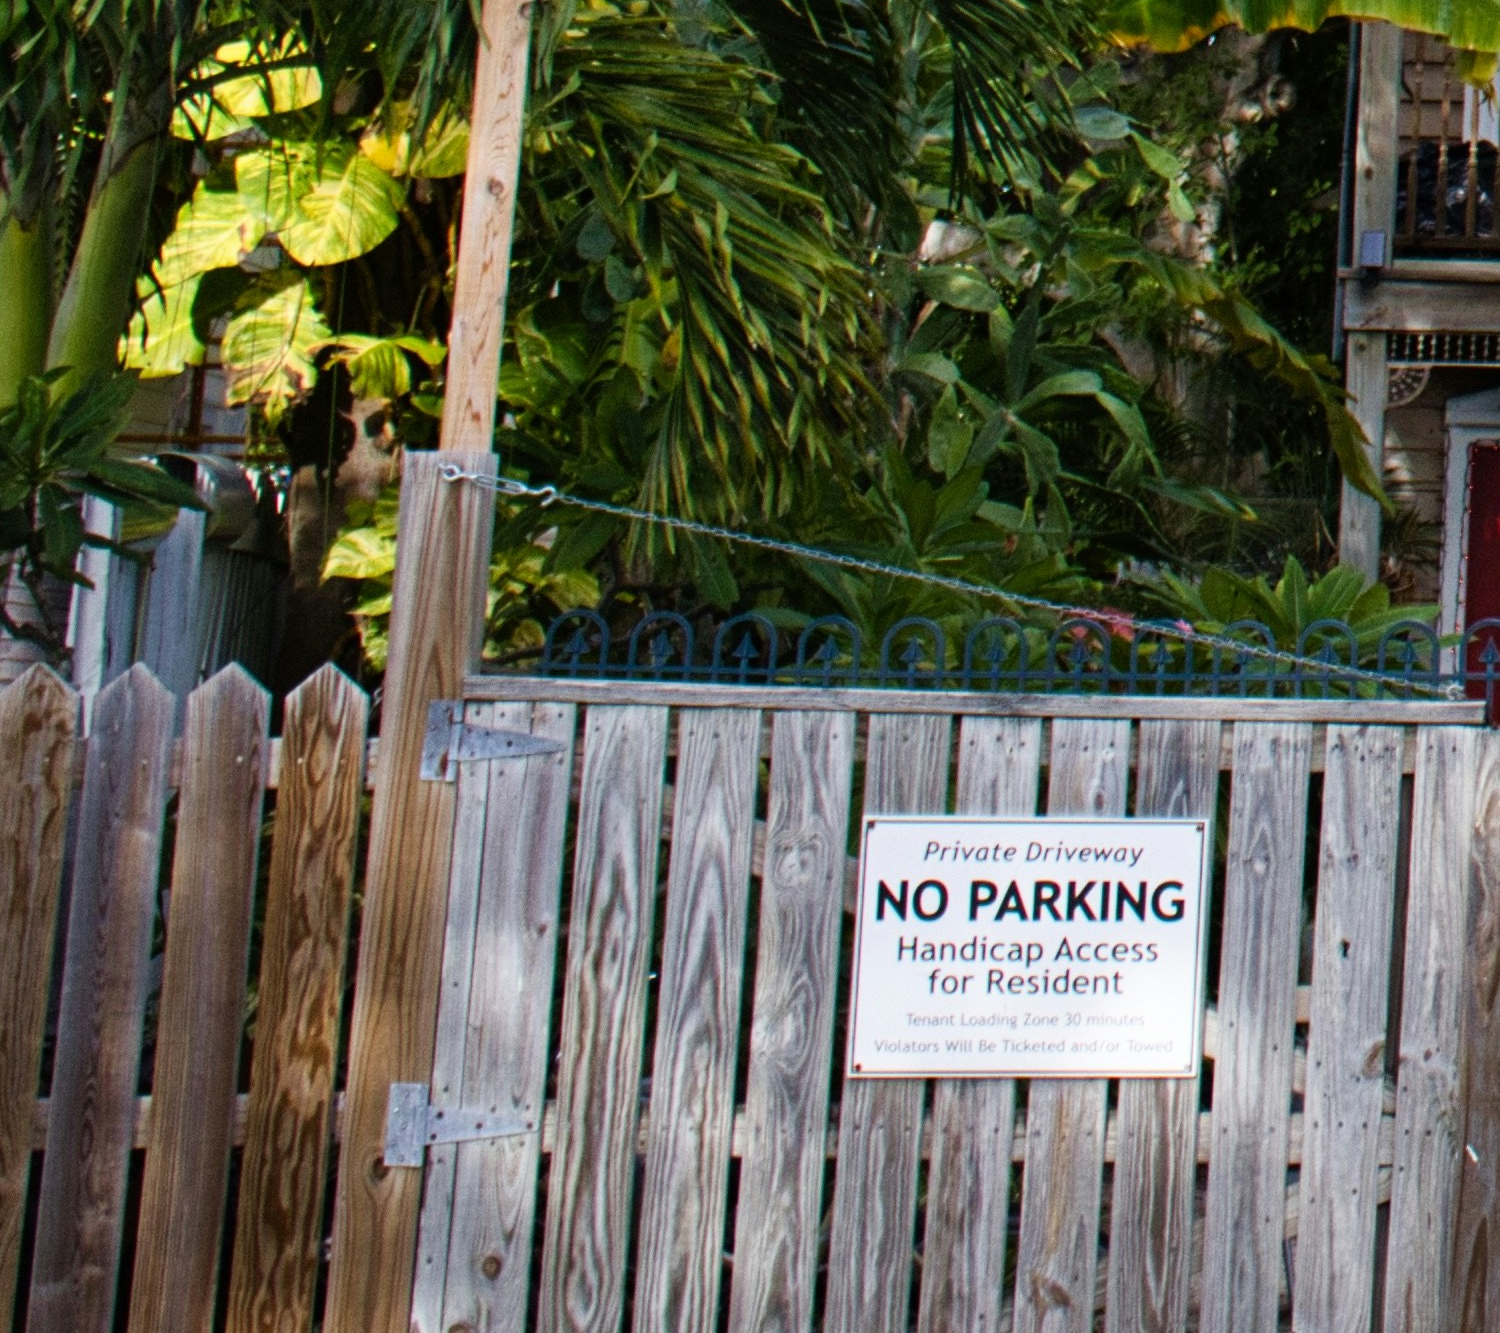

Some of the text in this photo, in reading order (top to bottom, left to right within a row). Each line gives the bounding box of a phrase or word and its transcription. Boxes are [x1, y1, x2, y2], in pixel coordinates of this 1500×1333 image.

[923, 840, 1144, 868] Private Driveway
[875, 879, 1186, 923] NO PARKING
[897, 936, 1159, 968] Handicap Access
[928, 968, 1124, 995] for Resident
[906, 1012, 1145, 1030] Tenant Loading Zone 30 minutes
[874, 1039, 1174, 1054] Violators Will Be Ticketed and/or Towed
